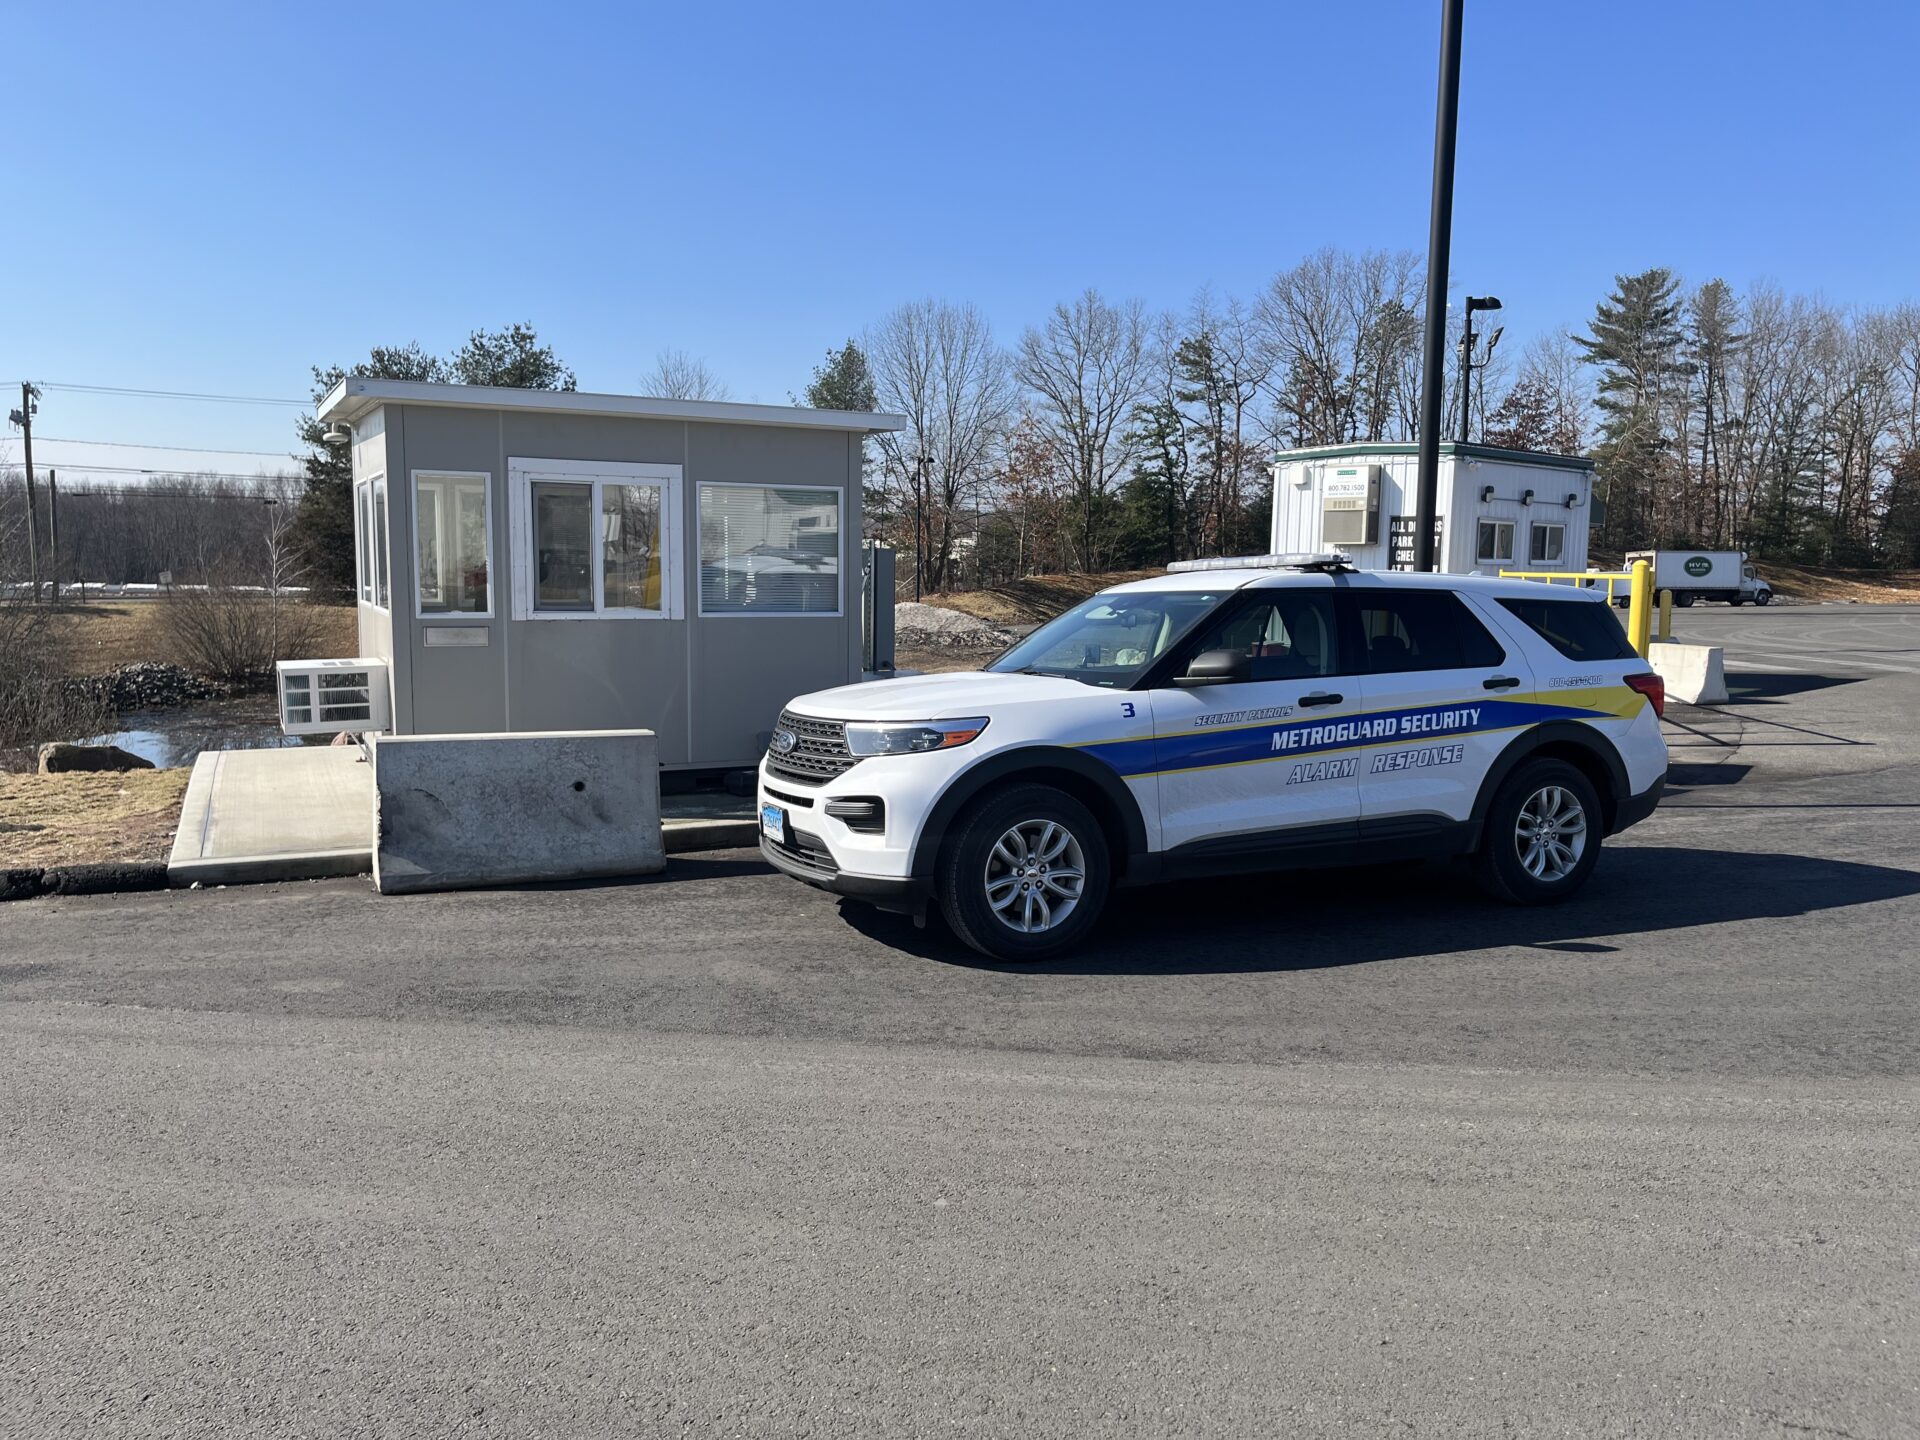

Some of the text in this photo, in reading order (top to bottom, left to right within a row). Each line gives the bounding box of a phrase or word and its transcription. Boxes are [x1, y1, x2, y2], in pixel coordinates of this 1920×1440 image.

[1391, 521, 1405, 533] ALL
[1392, 535, 1413, 547] PARK
[1395, 550, 1414, 562] CHEC
[1121, 702, 1136, 718] 3
[1194, 706, 1293, 726] SECURITY PATROLS
[1271, 708, 1480, 751] METROGUARD SECURITY
[1286, 744, 1464, 785] ALARM RESPONSE
